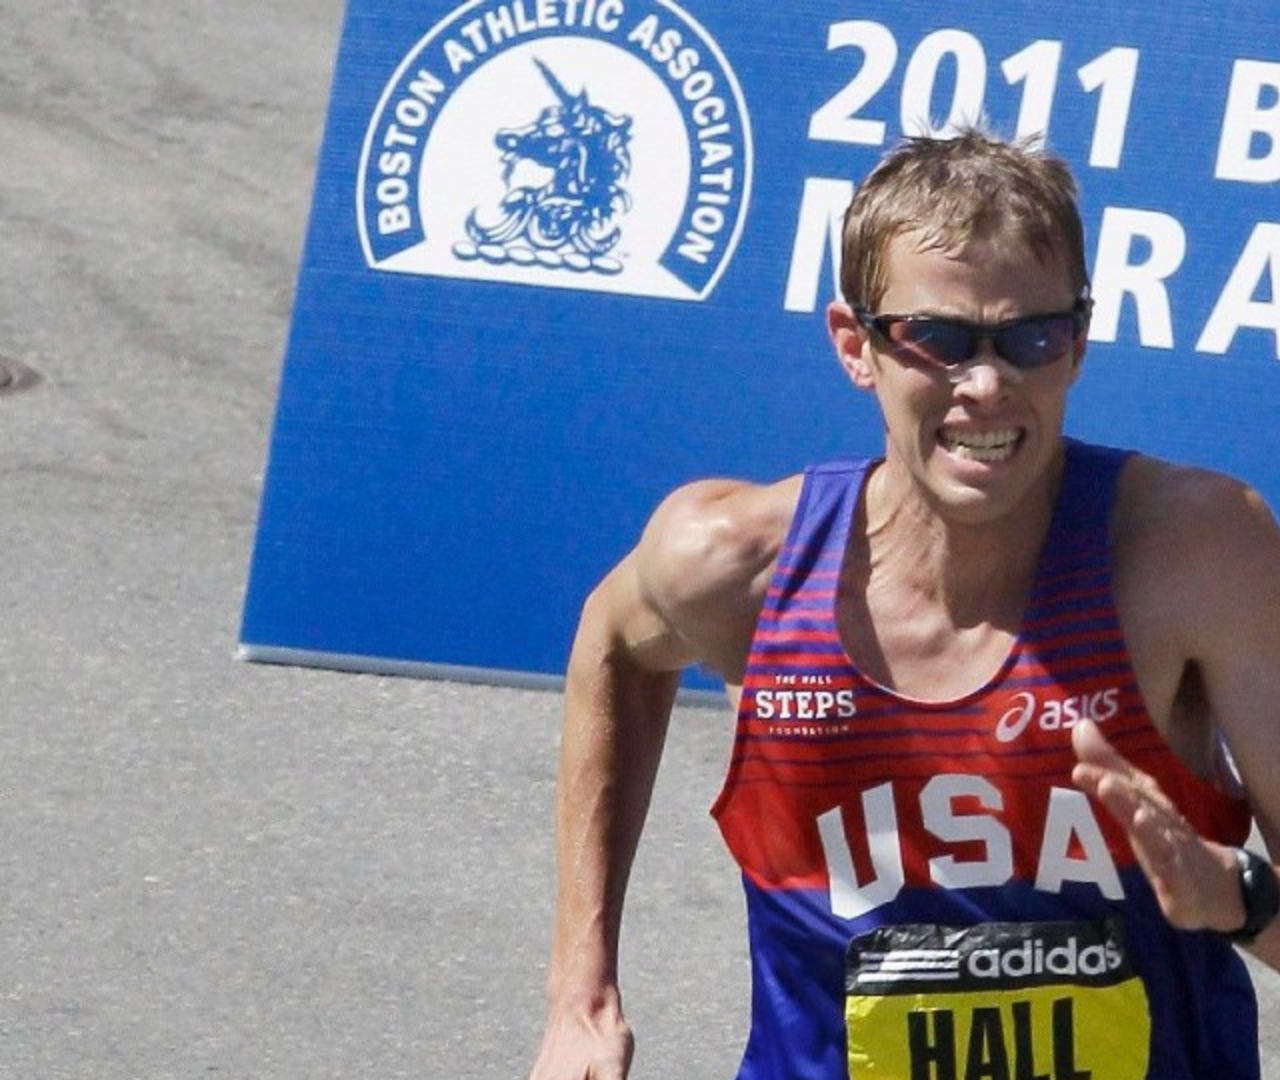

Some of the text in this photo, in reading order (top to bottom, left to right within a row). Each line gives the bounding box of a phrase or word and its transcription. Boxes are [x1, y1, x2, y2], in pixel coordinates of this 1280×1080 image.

[376, 0, 734, 265] BOSTON ATHLETIC ASSOCIATION
[808, 20, 1139, 169] 2011
[756, 689, 857, 719] STEPS
[1039, 688, 1119, 730] asics
[816, 773, 1125, 920] USA
[968, 936, 1122, 978] adidas
